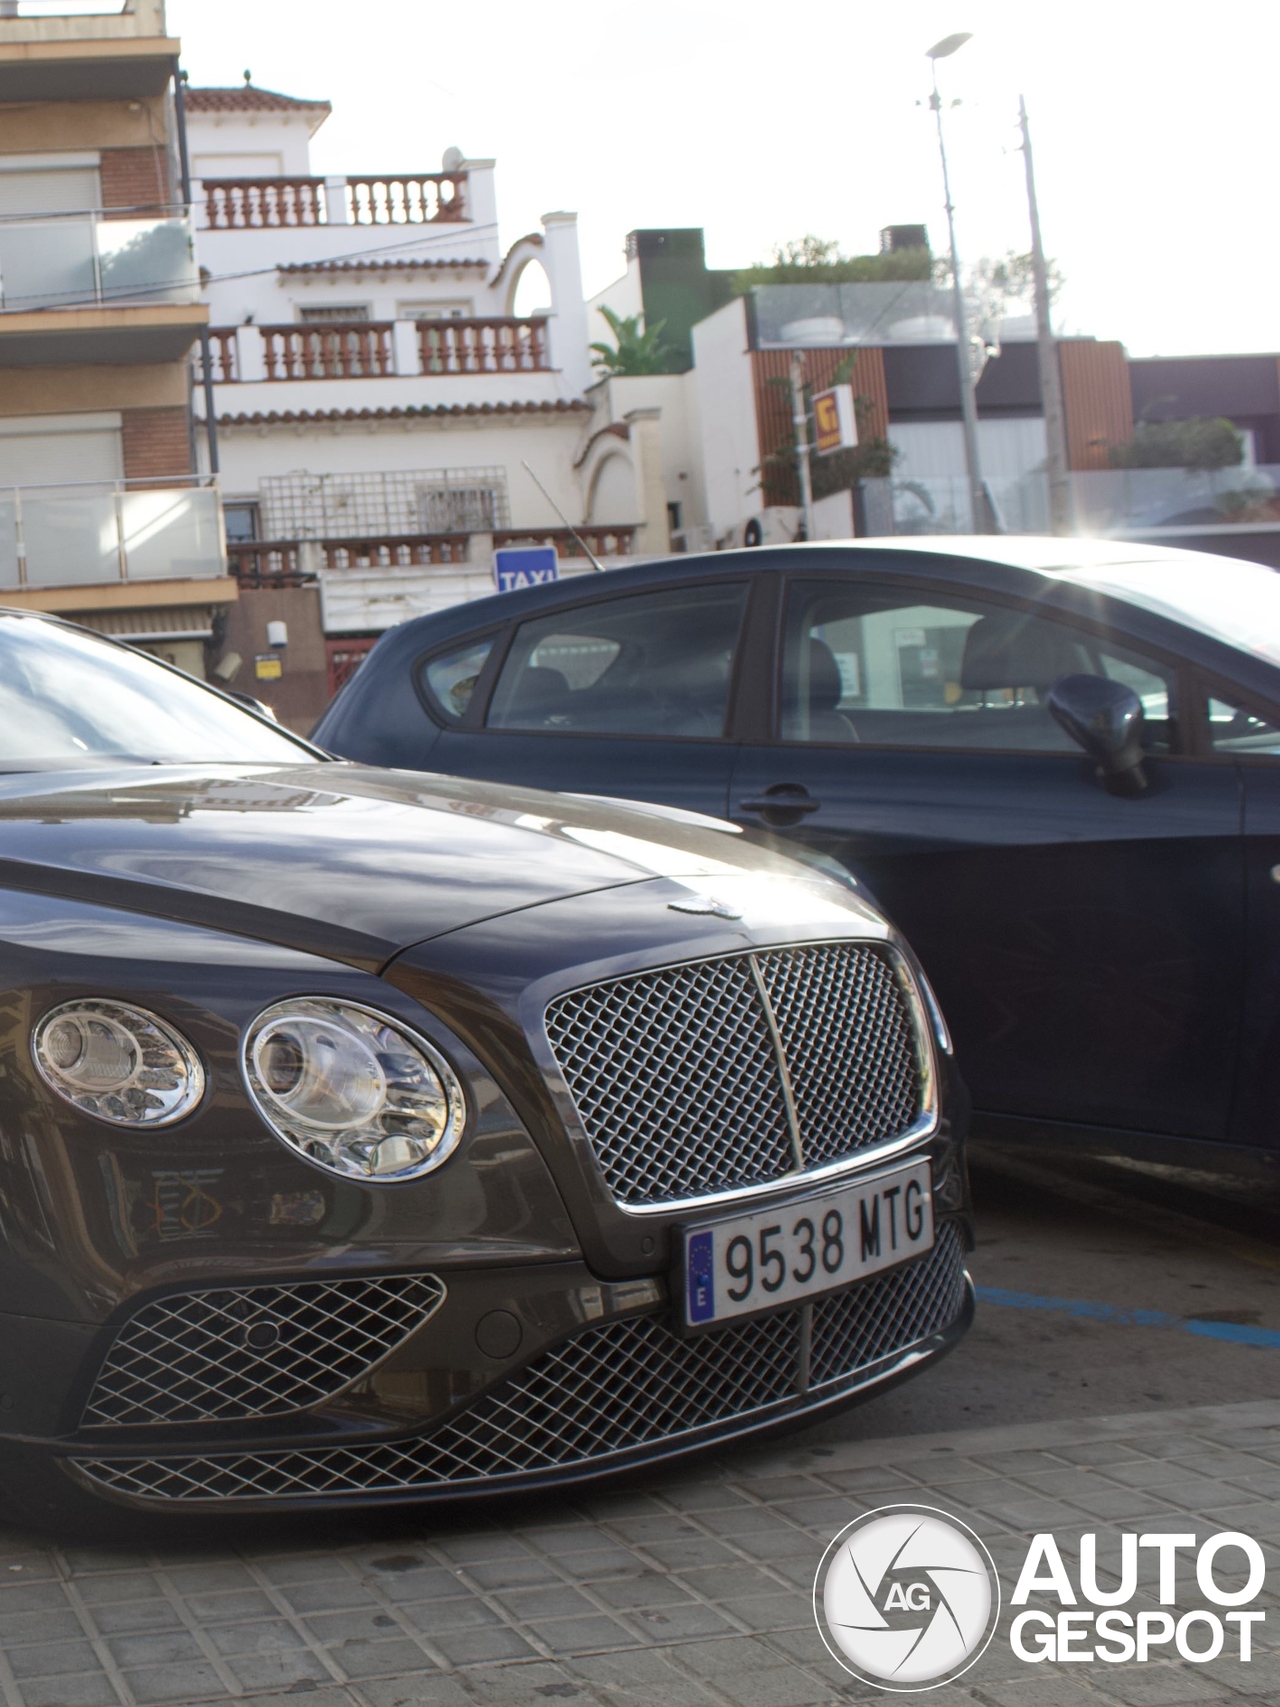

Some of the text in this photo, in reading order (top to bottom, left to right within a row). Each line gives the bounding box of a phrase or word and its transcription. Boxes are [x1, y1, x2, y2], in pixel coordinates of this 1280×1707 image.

[726, 1179, 923, 1302] 9538 MTG
[696, 1287, 706, 1307] E
